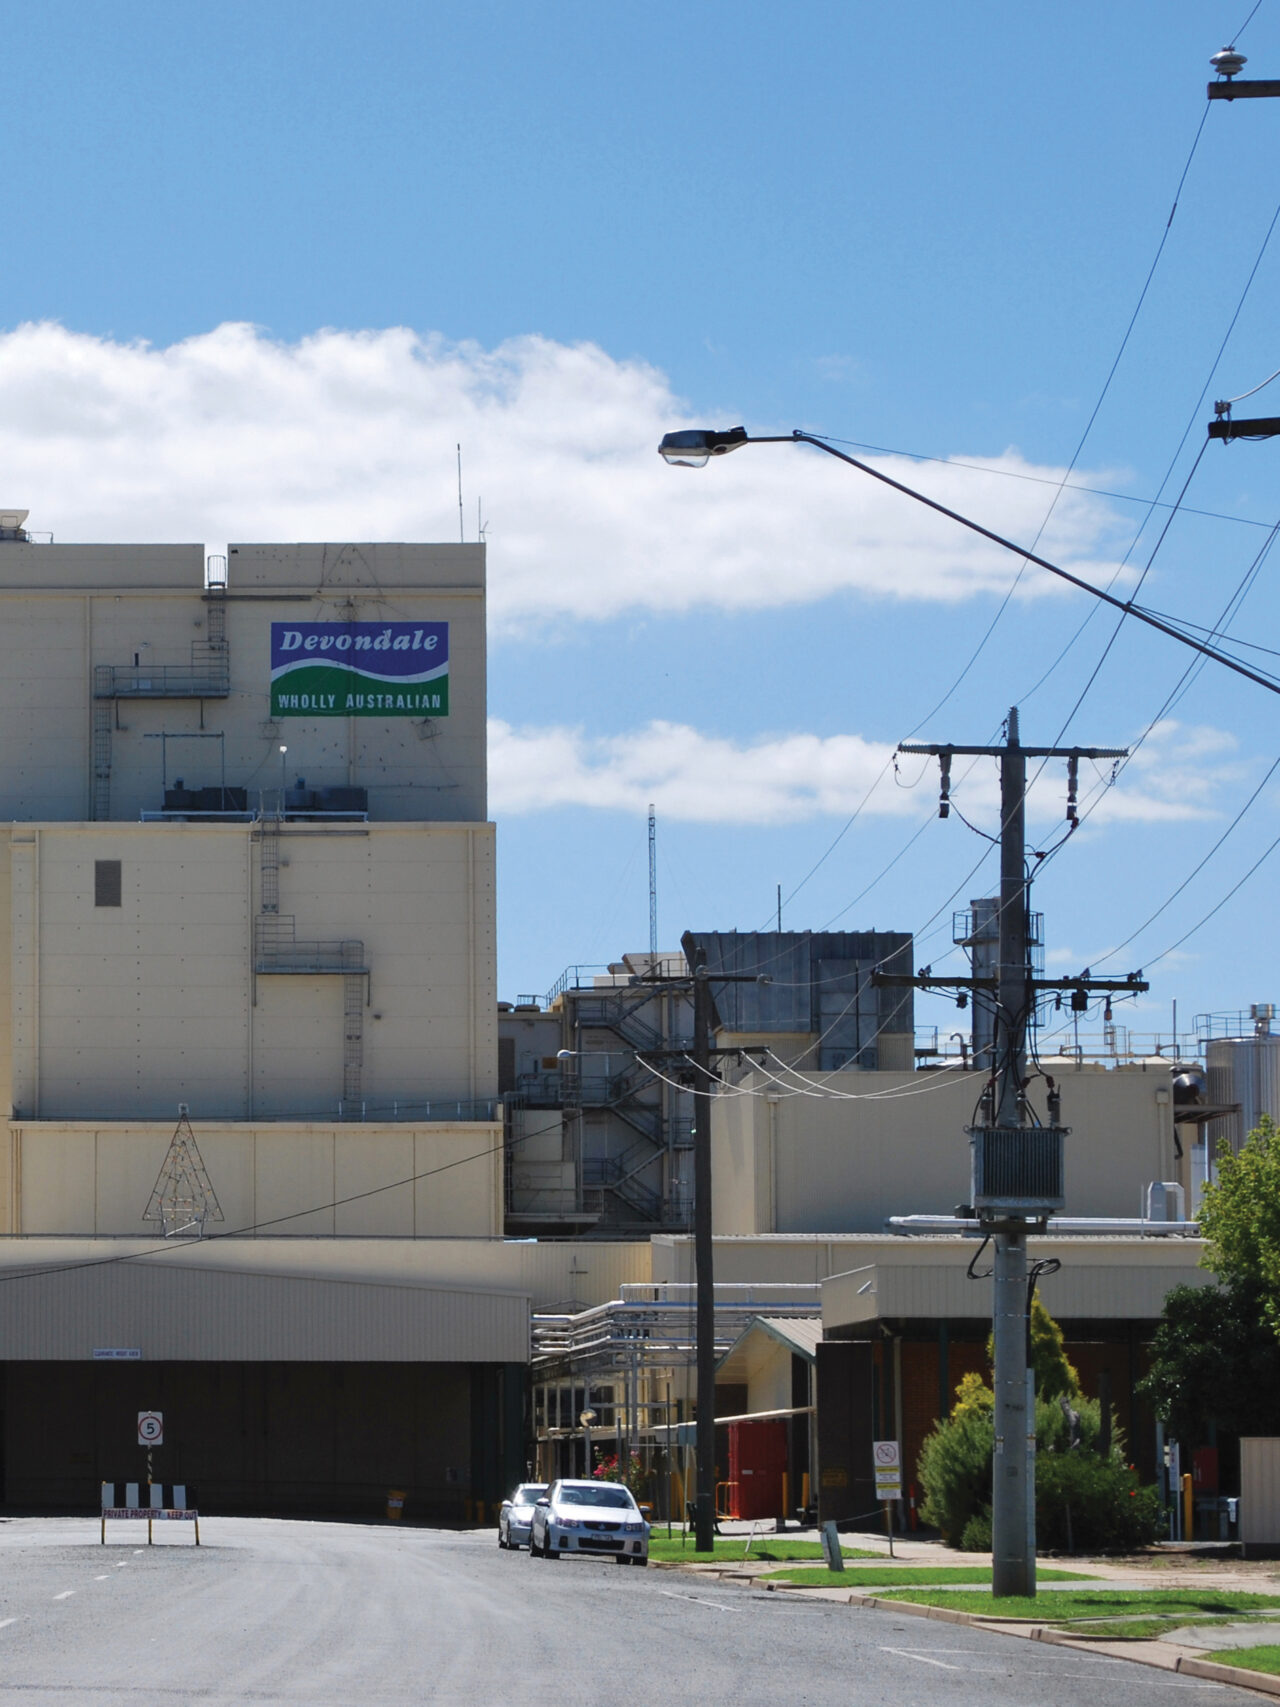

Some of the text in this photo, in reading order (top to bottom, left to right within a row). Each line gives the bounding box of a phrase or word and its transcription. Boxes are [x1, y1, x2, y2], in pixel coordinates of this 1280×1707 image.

[279, 628, 439, 651] Devondale
[278, 693, 441, 709] WHOLLY AUSTRALIAN
[146, 1422, 155, 1435] 5
[103, 1509, 198, 1520] PRIVATE PROPERTY KEEP OUT
